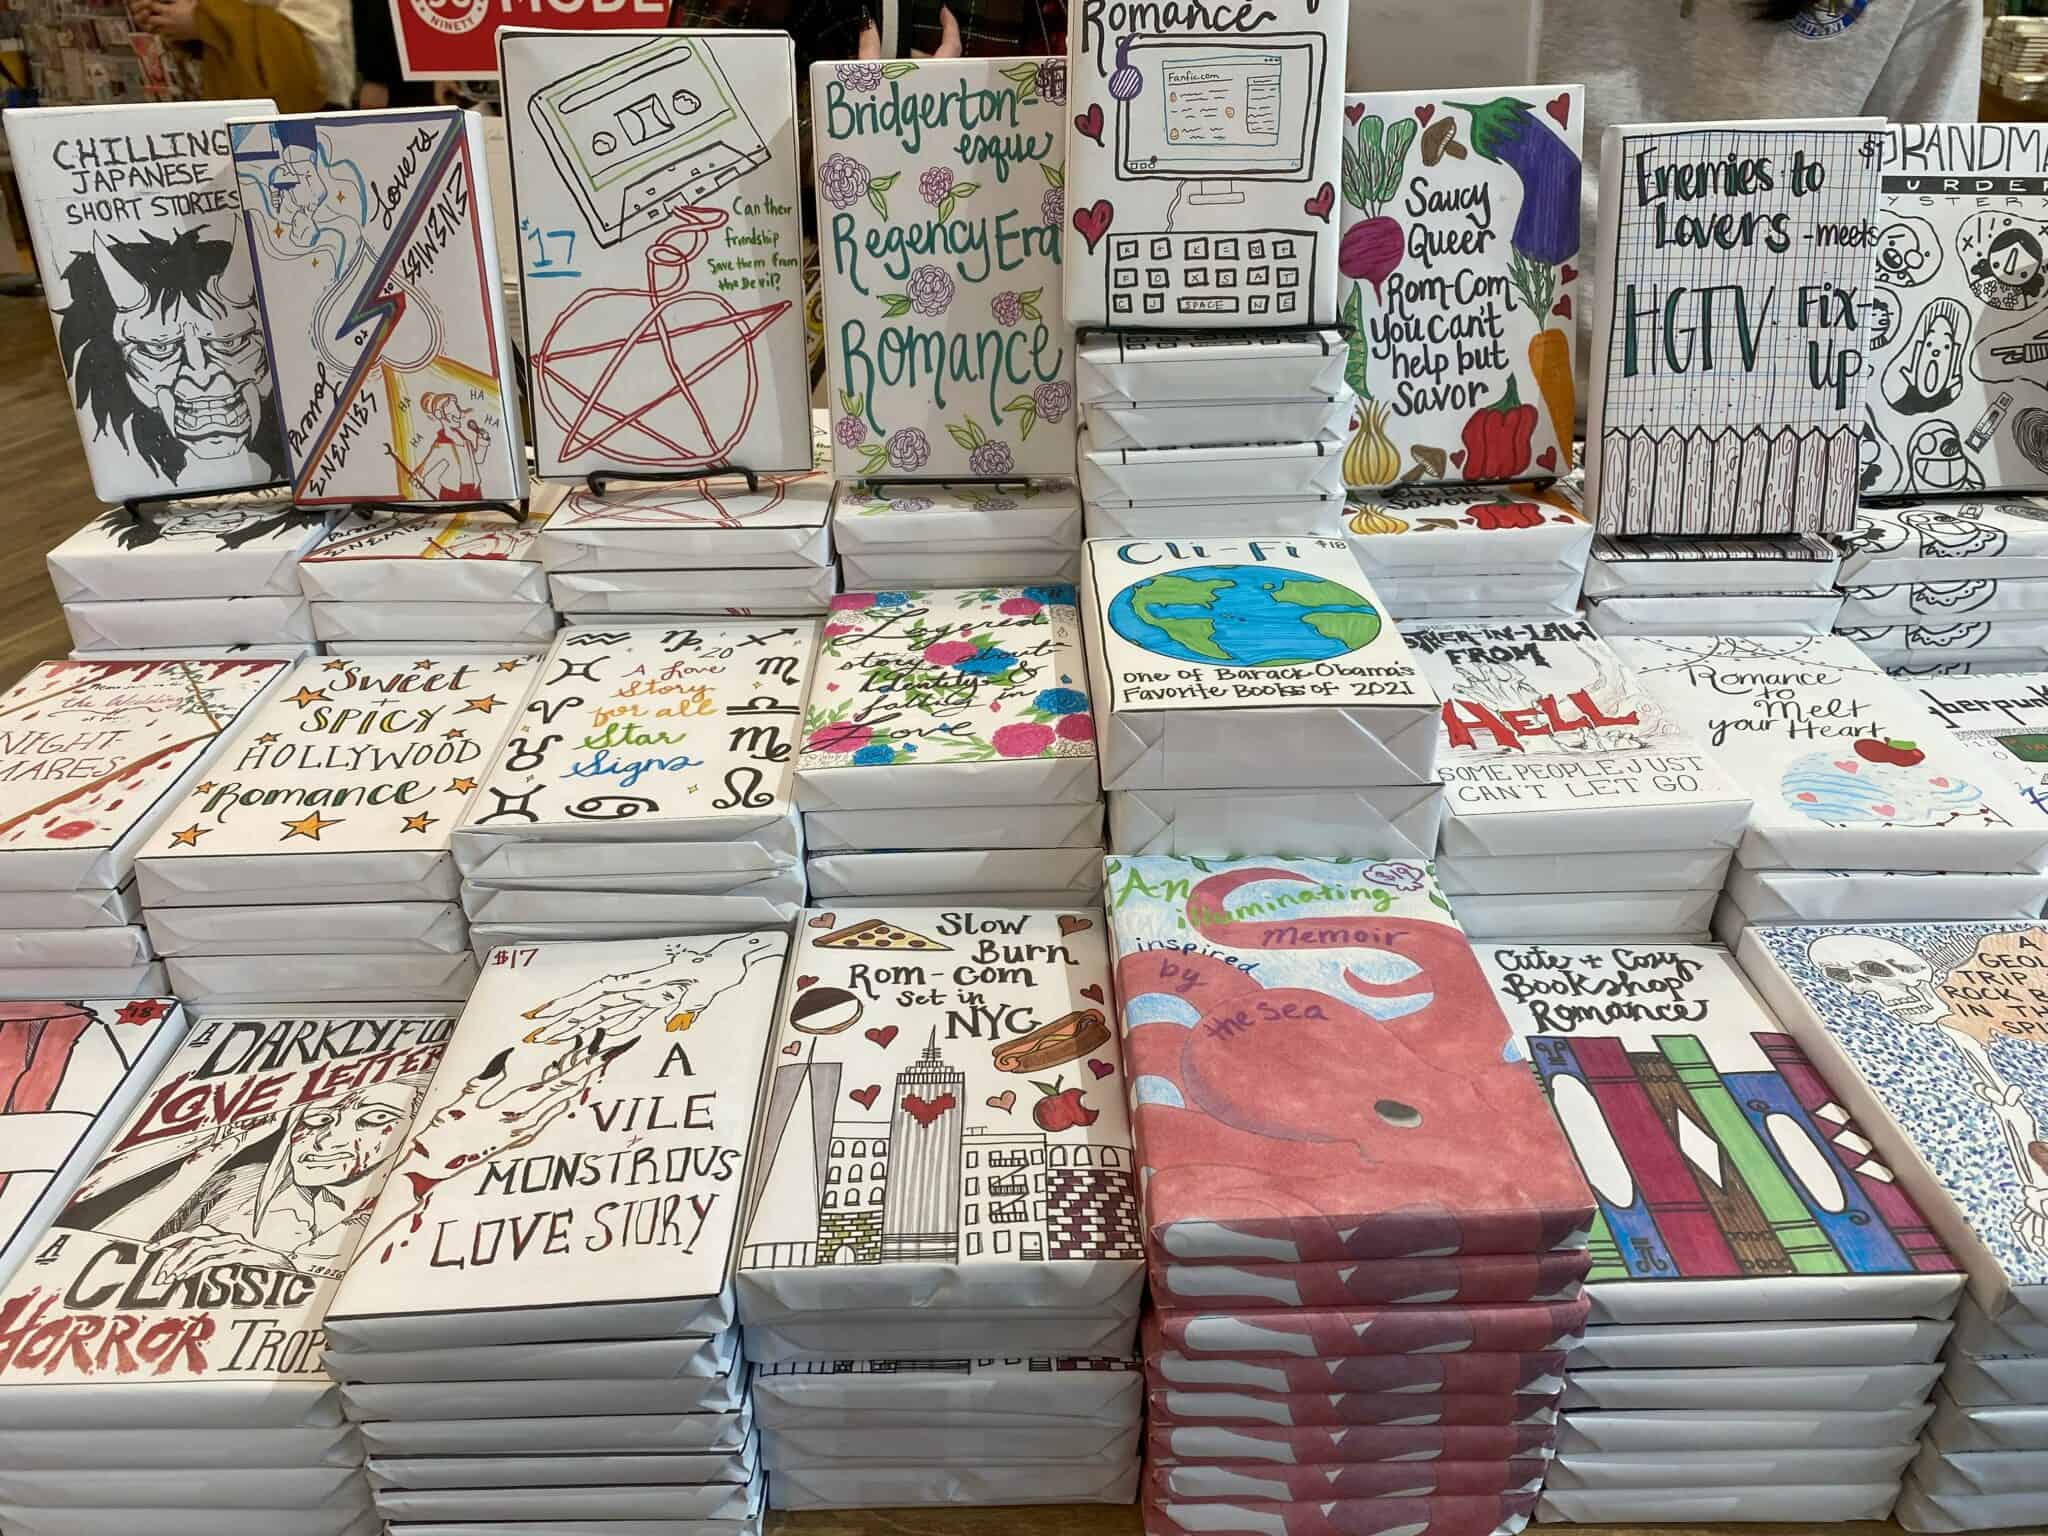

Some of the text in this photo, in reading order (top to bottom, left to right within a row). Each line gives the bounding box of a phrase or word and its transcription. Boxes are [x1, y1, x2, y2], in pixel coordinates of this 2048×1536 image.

[431, 16, 475, 32] NINETY
[1082, 0, 1277, 77] Romance
[1168, 71, 1220, 82] Fanfic.com
[53, 130, 229, 170] CHILLING
[954, 132, 1054, 183] esque
[72, 163, 210, 194] JAPANESE
[1637, 147, 1825, 206] Enemies to
[1907, 180, 2048, 192] URDE
[66, 190, 241, 225] SHORT STORIES
[732, 196, 760, 217] Can
[1405, 176, 1491, 229] Saucy
[1656, 203, 1791, 252] Lovers
[832, 209, 1062, 295] Regency Era
[1408, 223, 1495, 268] Queer
[707, 252, 798, 274] Save them from
[719, 277, 739, 291] the
[1624, 284, 1775, 377] HGTV
[1392, 339, 1509, 385] help but
[841, 319, 1063, 437] Romance
[1391, 380, 1489, 416] Savor
[1117, 541, 1301, 565] Cli-Fi
[1401, 621, 1598, 654] OTHER-IN-LAW
[621, 660, 727, 681] A Love
[1445, 643, 1552, 668] FROM
[329, 665, 479, 692] Sweet
[1177, 668, 1204, 682] of
[1217, 667, 1314, 682] Barack
[1315, 661, 1415, 678] Obama's
[1684, 665, 1842, 695] Romance
[610, 681, 716, 704] Story
[1124, 682, 1414, 703] Favorite Books of 2021
[1759, 686, 1795, 699] to
[300, 705, 446, 734] SPICY
[591, 699, 718, 728] for all
[1441, 688, 1640, 753] HELL
[1754, 698, 1872, 723] Melt
[572, 722, 688, 750] Star
[1708, 717, 1888, 746] your Heart
[234, 739, 481, 771] HOLLYWOOD
[560, 750, 704, 788] Signs
[1438, 756, 1704, 782] SOME PEOPLE JUST
[200, 780, 437, 824] Romance
[1458, 784, 1547, 802] CAN'T
[1565, 778, 1640, 798] LET
[1114, 866, 1191, 907] An
[936, 912, 1032, 935] Slow
[491, 948, 539, 968] $17
[971, 940, 1079, 966] Burn
[1135, 936, 1261, 974] inspired
[2019, 936, 2042, 951] A
[1159, 959, 1208, 992] by
[1495, 946, 1572, 971] Cute
[1611, 948, 1703, 982] Cozy
[1955, 971, 2027, 985] TRIP
[958, 990, 984, 1006] in
[1942, 986, 2023, 1001] ROCK
[945, 1004, 1042, 1040] NYC
[1203, 1008, 1256, 1041] the
[1529, 1000, 1709, 1033] Romance
[1956, 1003, 1994, 1017] IN
[192, 1022, 213, 1043] A
[194, 1019, 399, 1081] DARKLY
[654, 1043, 696, 1078] A
[113, 1070, 297, 1152] LOVE
[589, 1091, 717, 1132] VILE
[474, 1145, 743, 1196] MONSTROUS
[37, 1234, 72, 1258] A
[430, 1195, 719, 1269] LOVE STORY
[64, 1242, 316, 1309] CLASSIC
[0, 1287, 216, 1376] HORROR
